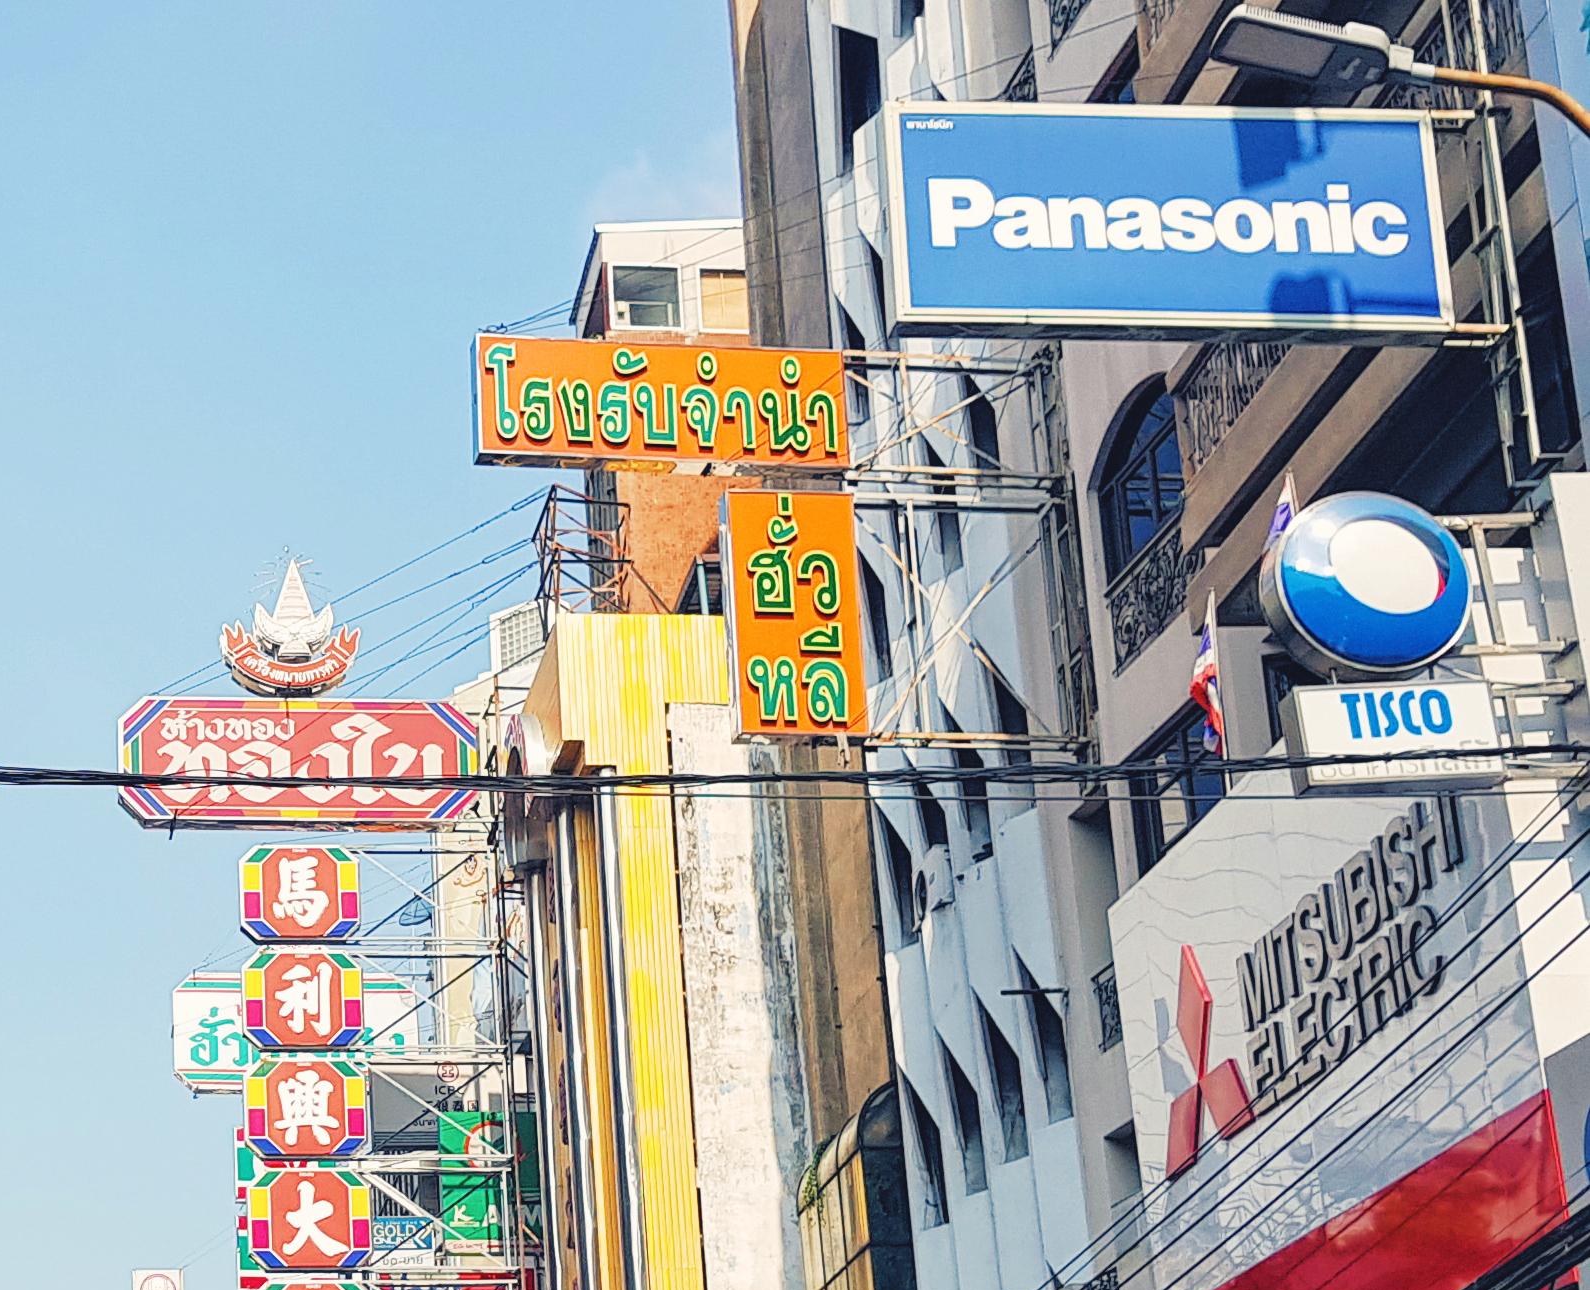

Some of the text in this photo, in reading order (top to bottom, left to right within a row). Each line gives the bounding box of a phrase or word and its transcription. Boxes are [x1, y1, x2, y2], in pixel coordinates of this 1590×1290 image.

[927, 177, 1410, 256] Panasonic
[485, 342, 838, 453] โรงรับจำนำ
[748, 492, 840, 615] ฮั่ว
[747, 622, 850, 723] หลี
[1340, 688, 1453, 740] TISCO
[159, 709, 296, 741] ห้างทอง
[1235, 795, 1465, 1032] MITSUBISHI
[1244, 900, 1451, 1104] ELECTRIC
[373, 1223, 418, 1238] GOLD
